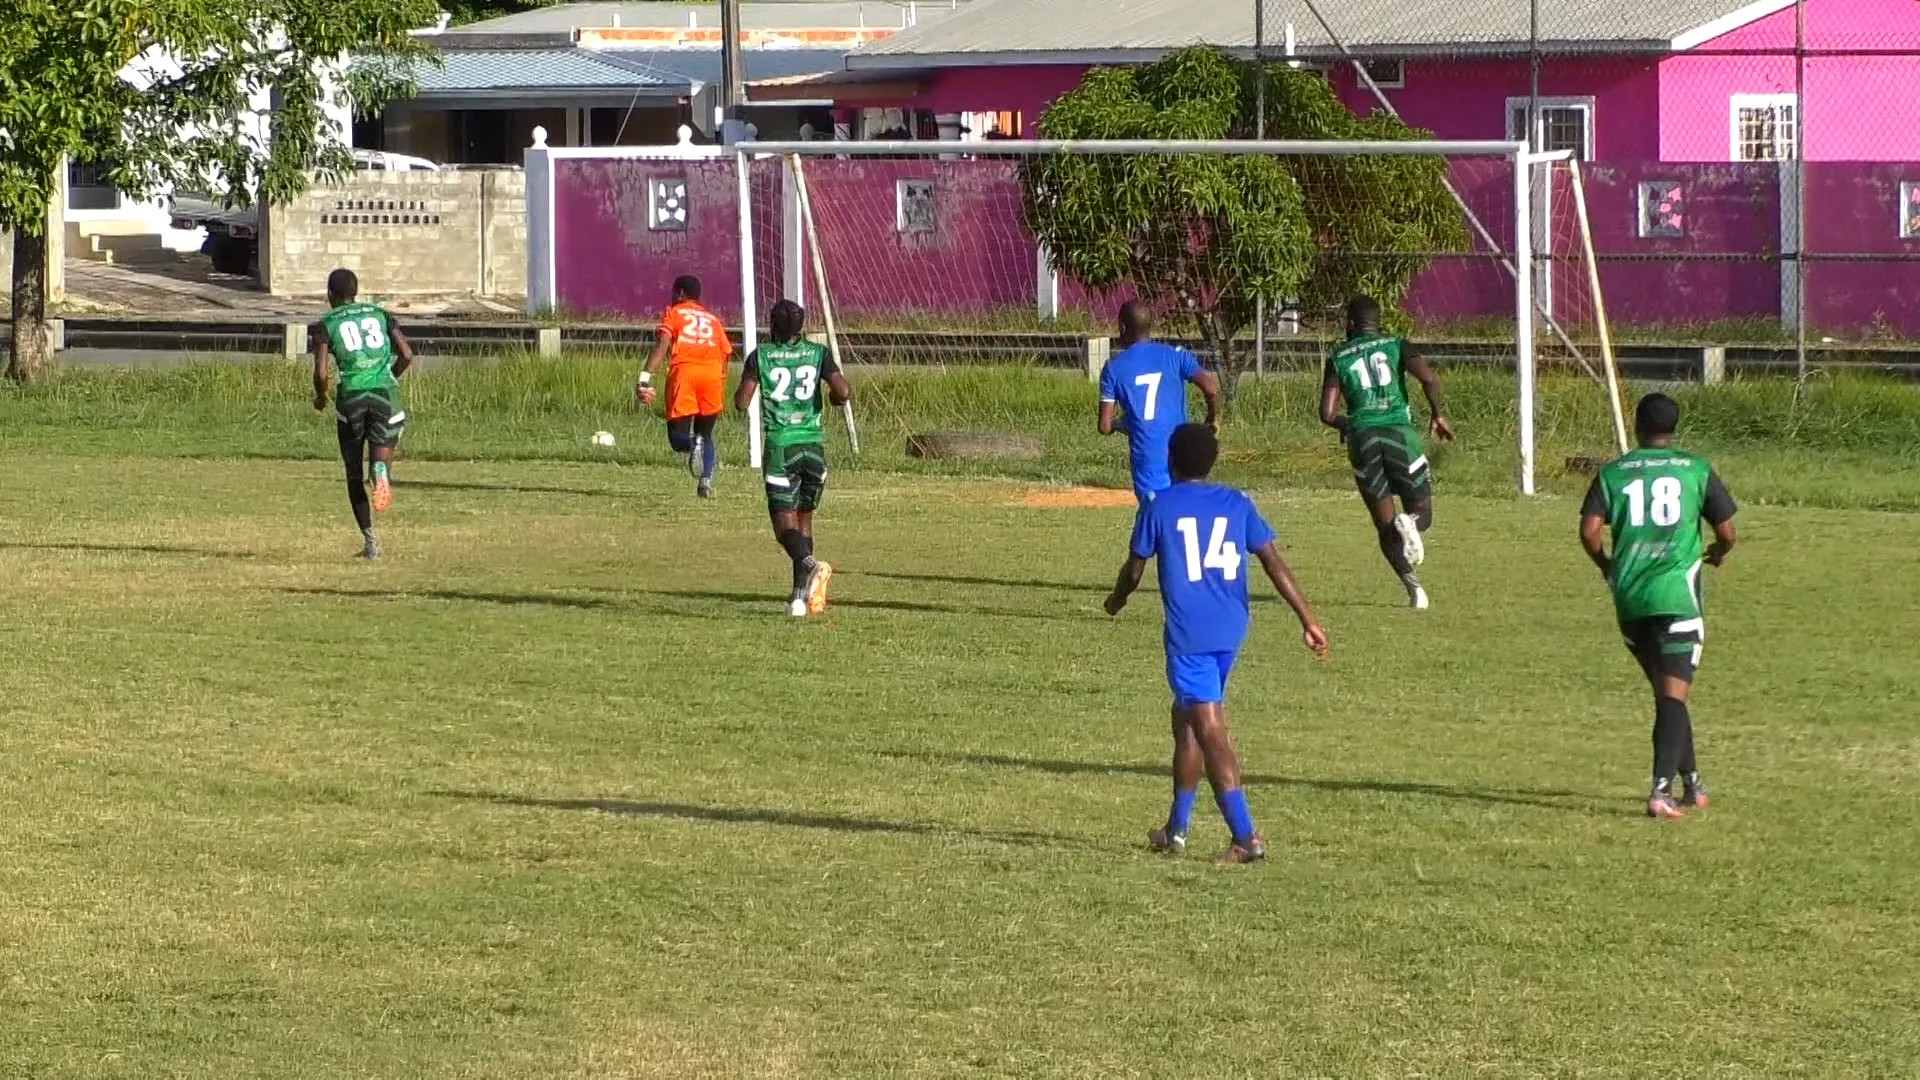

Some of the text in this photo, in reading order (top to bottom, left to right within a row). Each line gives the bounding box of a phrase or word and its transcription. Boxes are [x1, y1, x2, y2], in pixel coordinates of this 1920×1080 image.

[340, 317, 384, 352] 03
[683, 315, 713, 338] 25
[769, 365, 817, 401] 23
[1349, 351, 1392, 389] 16
[1135, 372, 1162, 420] 7
[1622, 477, 1681, 526] 18
[1176, 516, 1241, 582] 14
